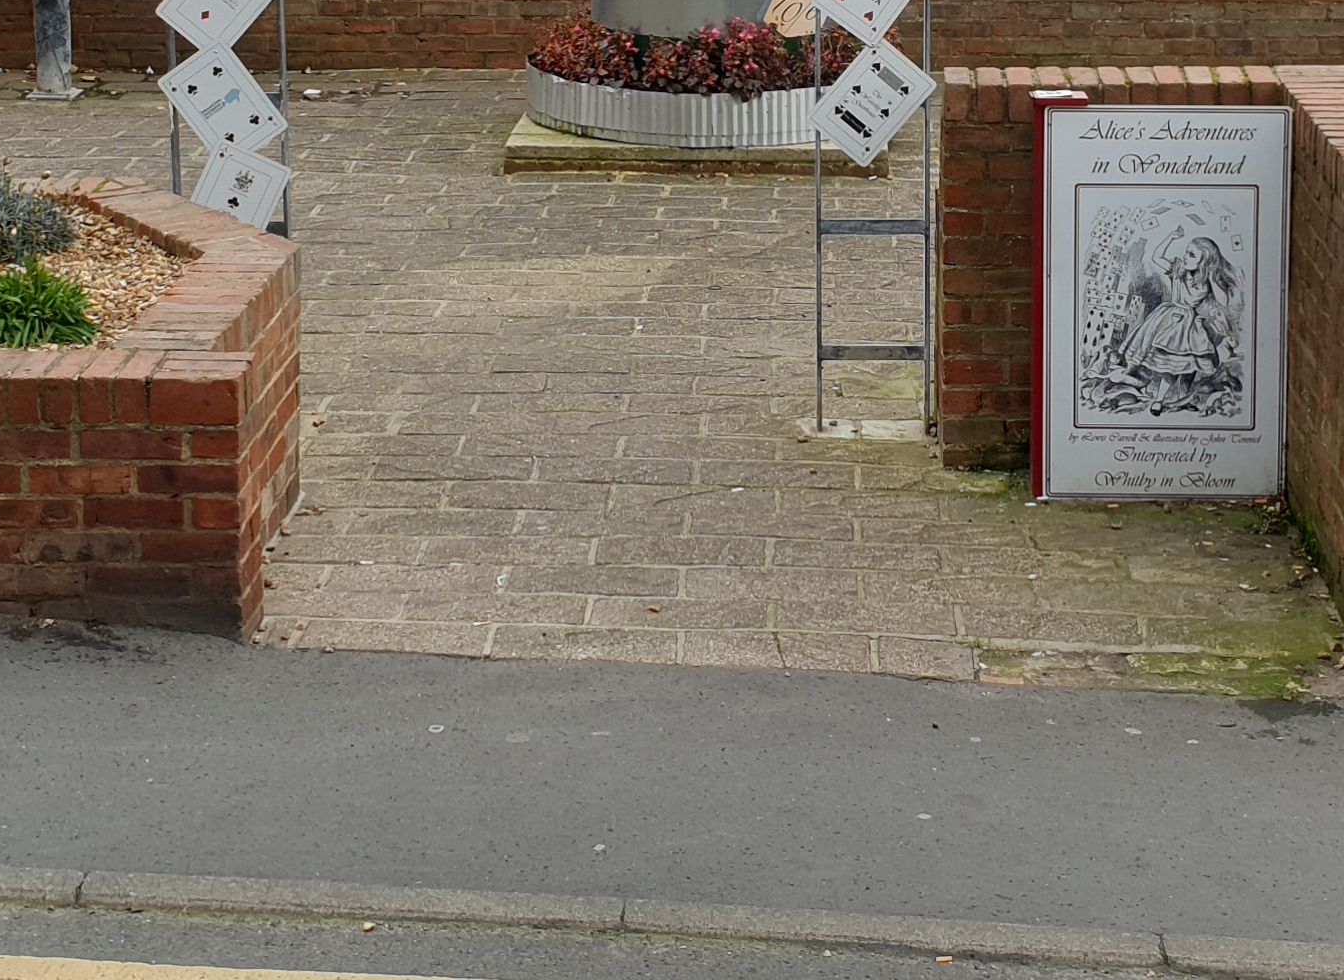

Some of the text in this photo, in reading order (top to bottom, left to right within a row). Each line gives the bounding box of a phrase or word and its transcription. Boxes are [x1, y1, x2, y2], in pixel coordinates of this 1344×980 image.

[1079, 118, 1258, 141] Alice's Adventures
[1091, 153, 1247, 175] in Wonderland
[1068, 433, 1079, 444] by
[1081, 432, 1107, 442] Lewis
[1108, 432, 1137, 442] Carroll
[1188, 433, 1199, 445] by
[1200, 433, 1227, 446] John
[1229, 434, 1262, 444] Tenniel
[1113, 446, 1218, 467] Interpreted by
[1095, 470, 1236, 492] Whitby in Bloom
